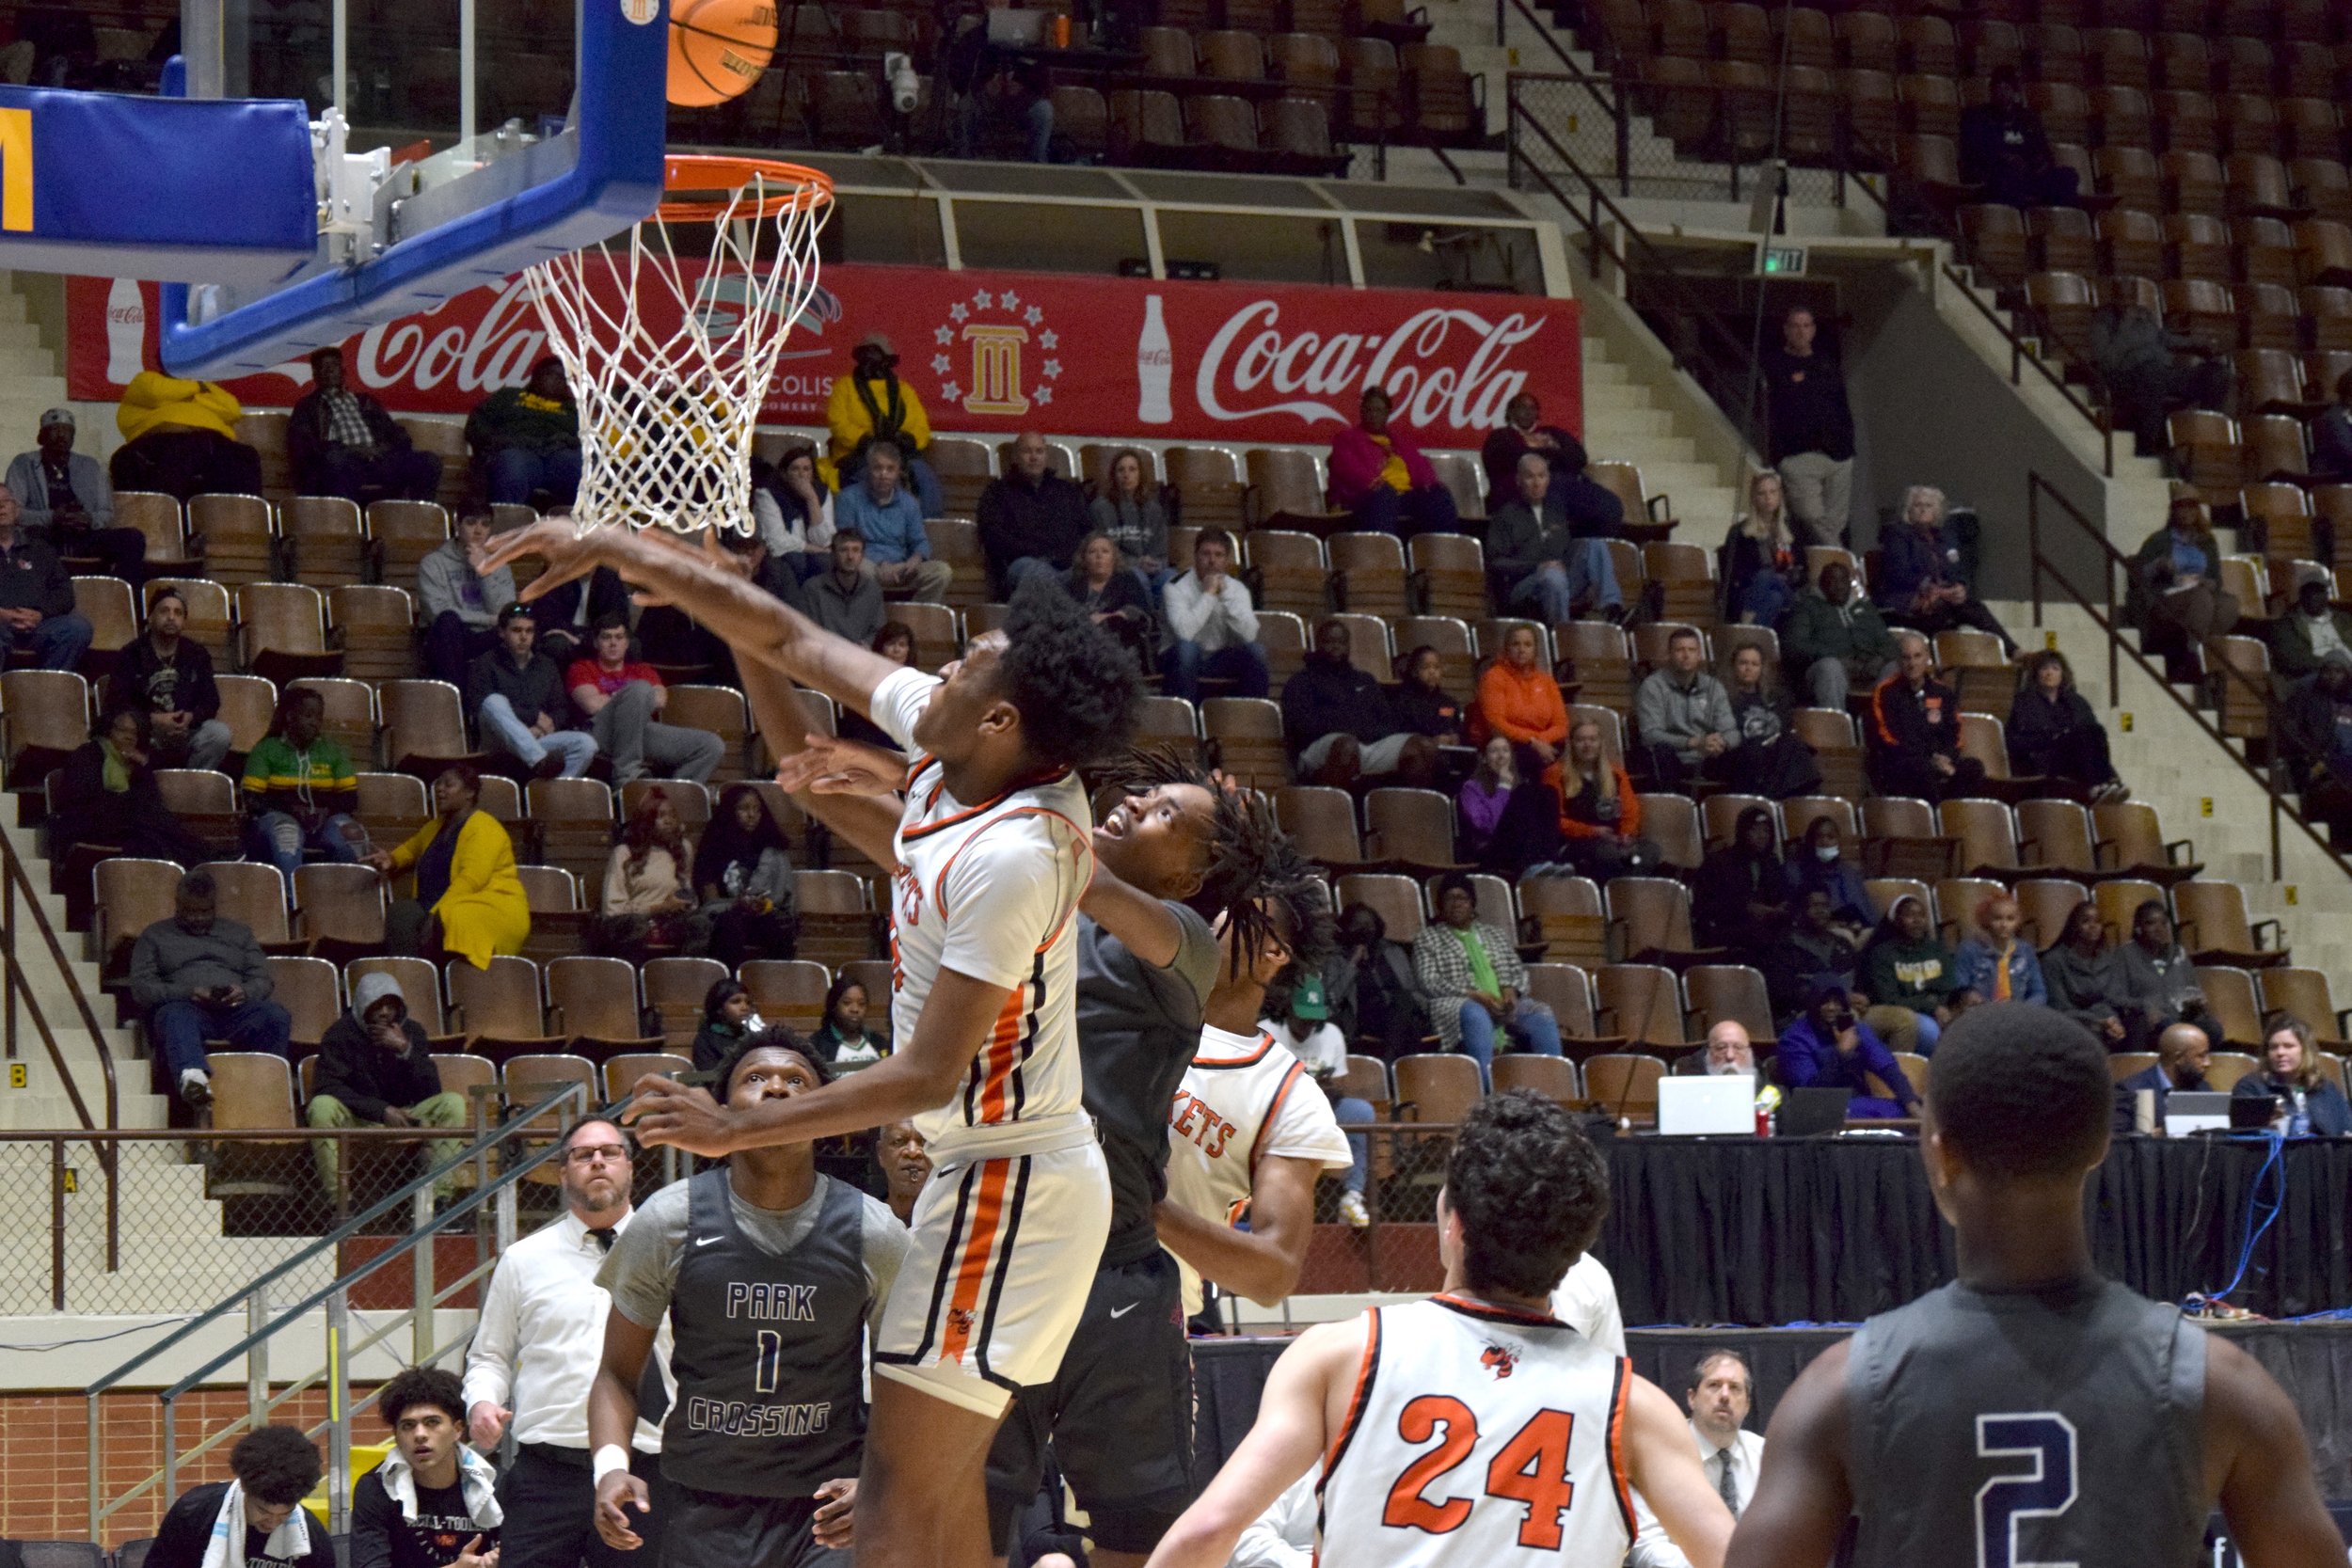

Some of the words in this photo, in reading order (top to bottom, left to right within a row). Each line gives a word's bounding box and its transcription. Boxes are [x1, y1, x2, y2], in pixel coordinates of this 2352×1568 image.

[1197, 300, 1547, 429] Coca-Cola
[766, 375, 834, 397] COLIS
[10, 1064, 26, 1087] B
[63, 1168, 77, 1192] A
[726, 1282, 818, 1322] PARK
[755, 1329, 782, 1393] 1
[689, 1396, 831, 1437] CROSSING
[1381, 1394, 1577, 1552] 24
[1974, 1412, 2079, 1568] 2
